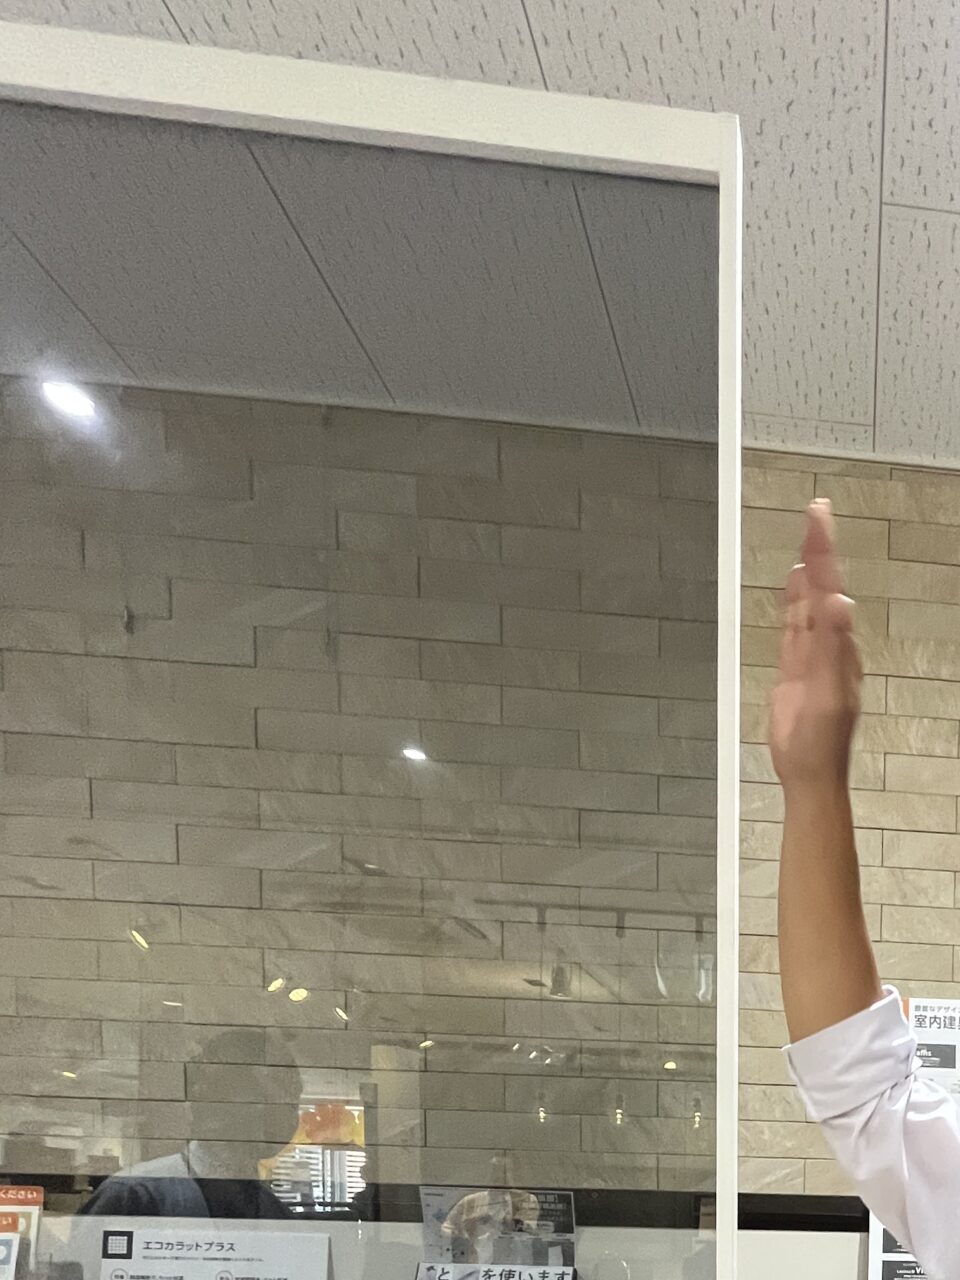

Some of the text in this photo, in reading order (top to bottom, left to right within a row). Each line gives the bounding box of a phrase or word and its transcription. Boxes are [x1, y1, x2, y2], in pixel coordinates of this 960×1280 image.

[142, 1241, 237, 1252] エコカラットプラス
